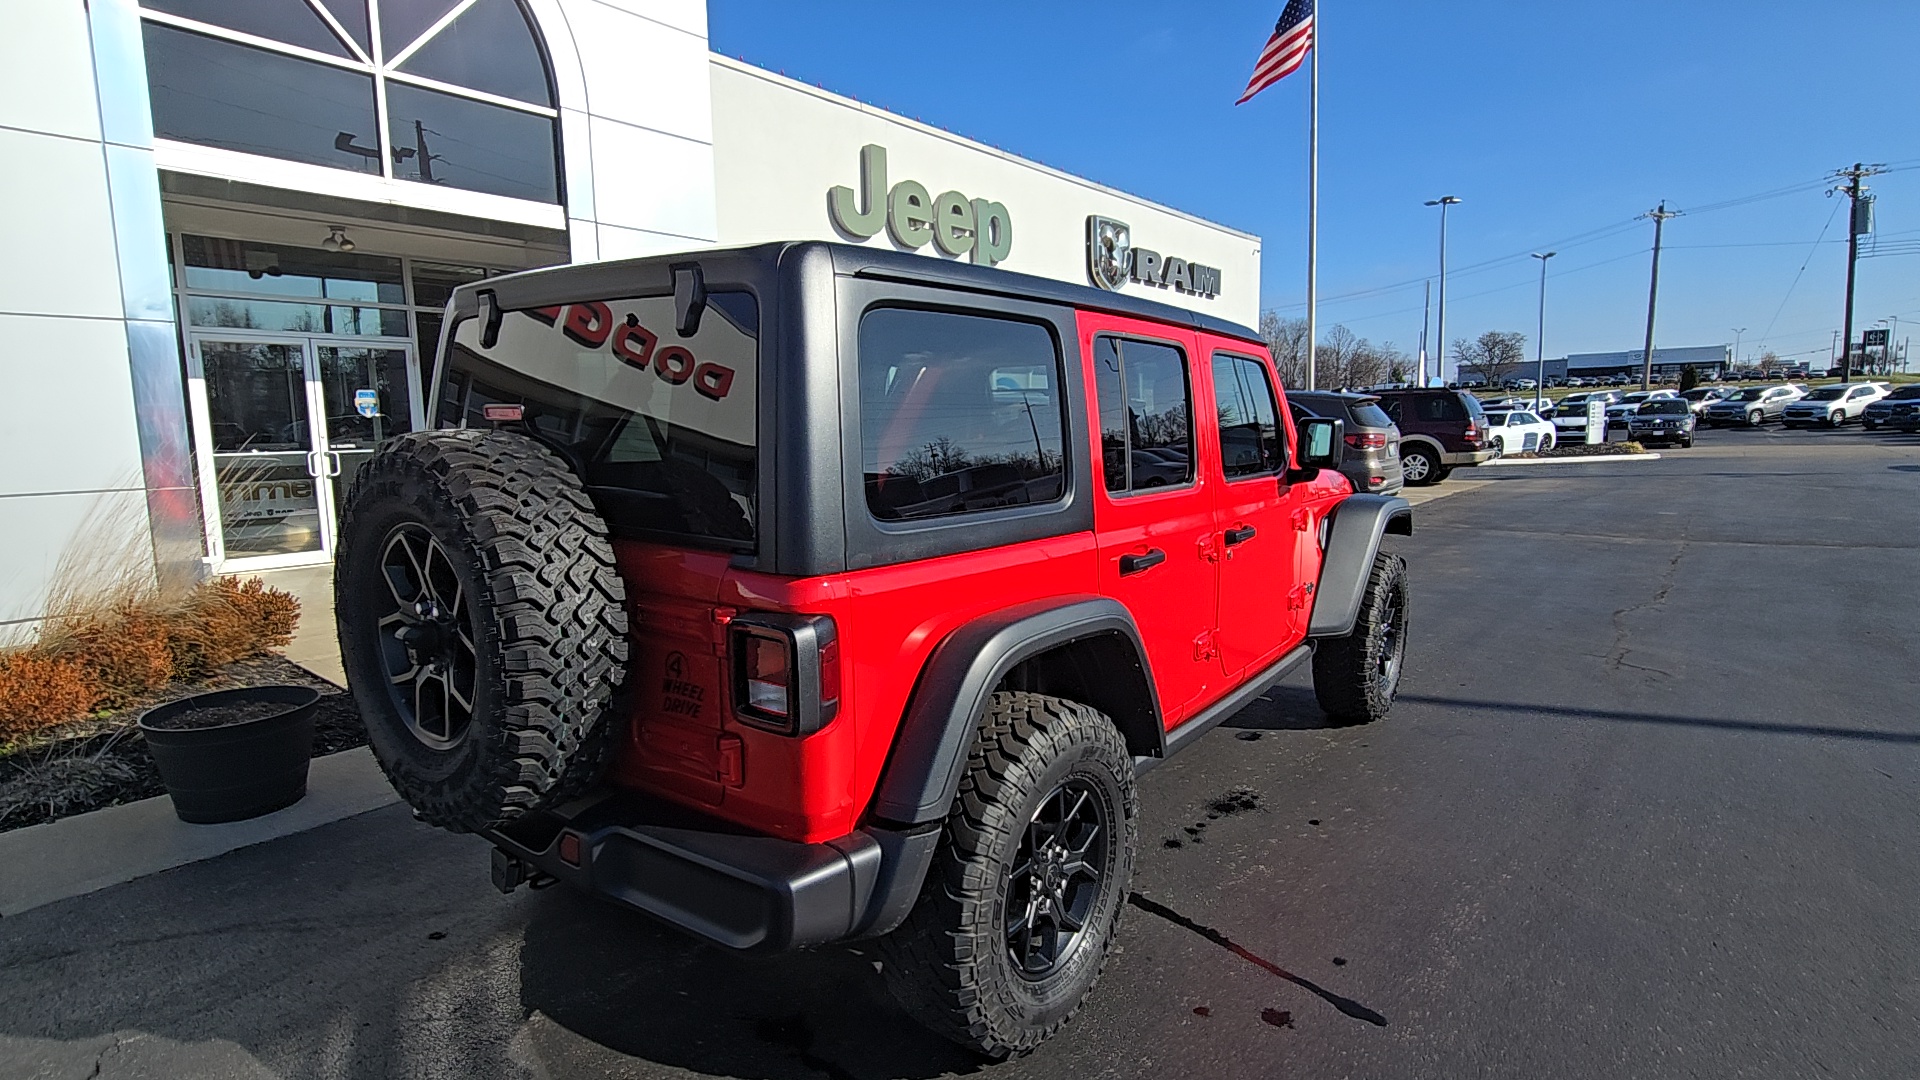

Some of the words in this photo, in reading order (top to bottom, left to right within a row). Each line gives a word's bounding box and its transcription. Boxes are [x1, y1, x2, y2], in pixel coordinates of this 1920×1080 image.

[827, 144, 1012, 266] Jeep
[1130, 247, 1222, 298] RAM
[662, 678, 705, 702] WHEEL
[663, 696, 702, 718] DRIVE
